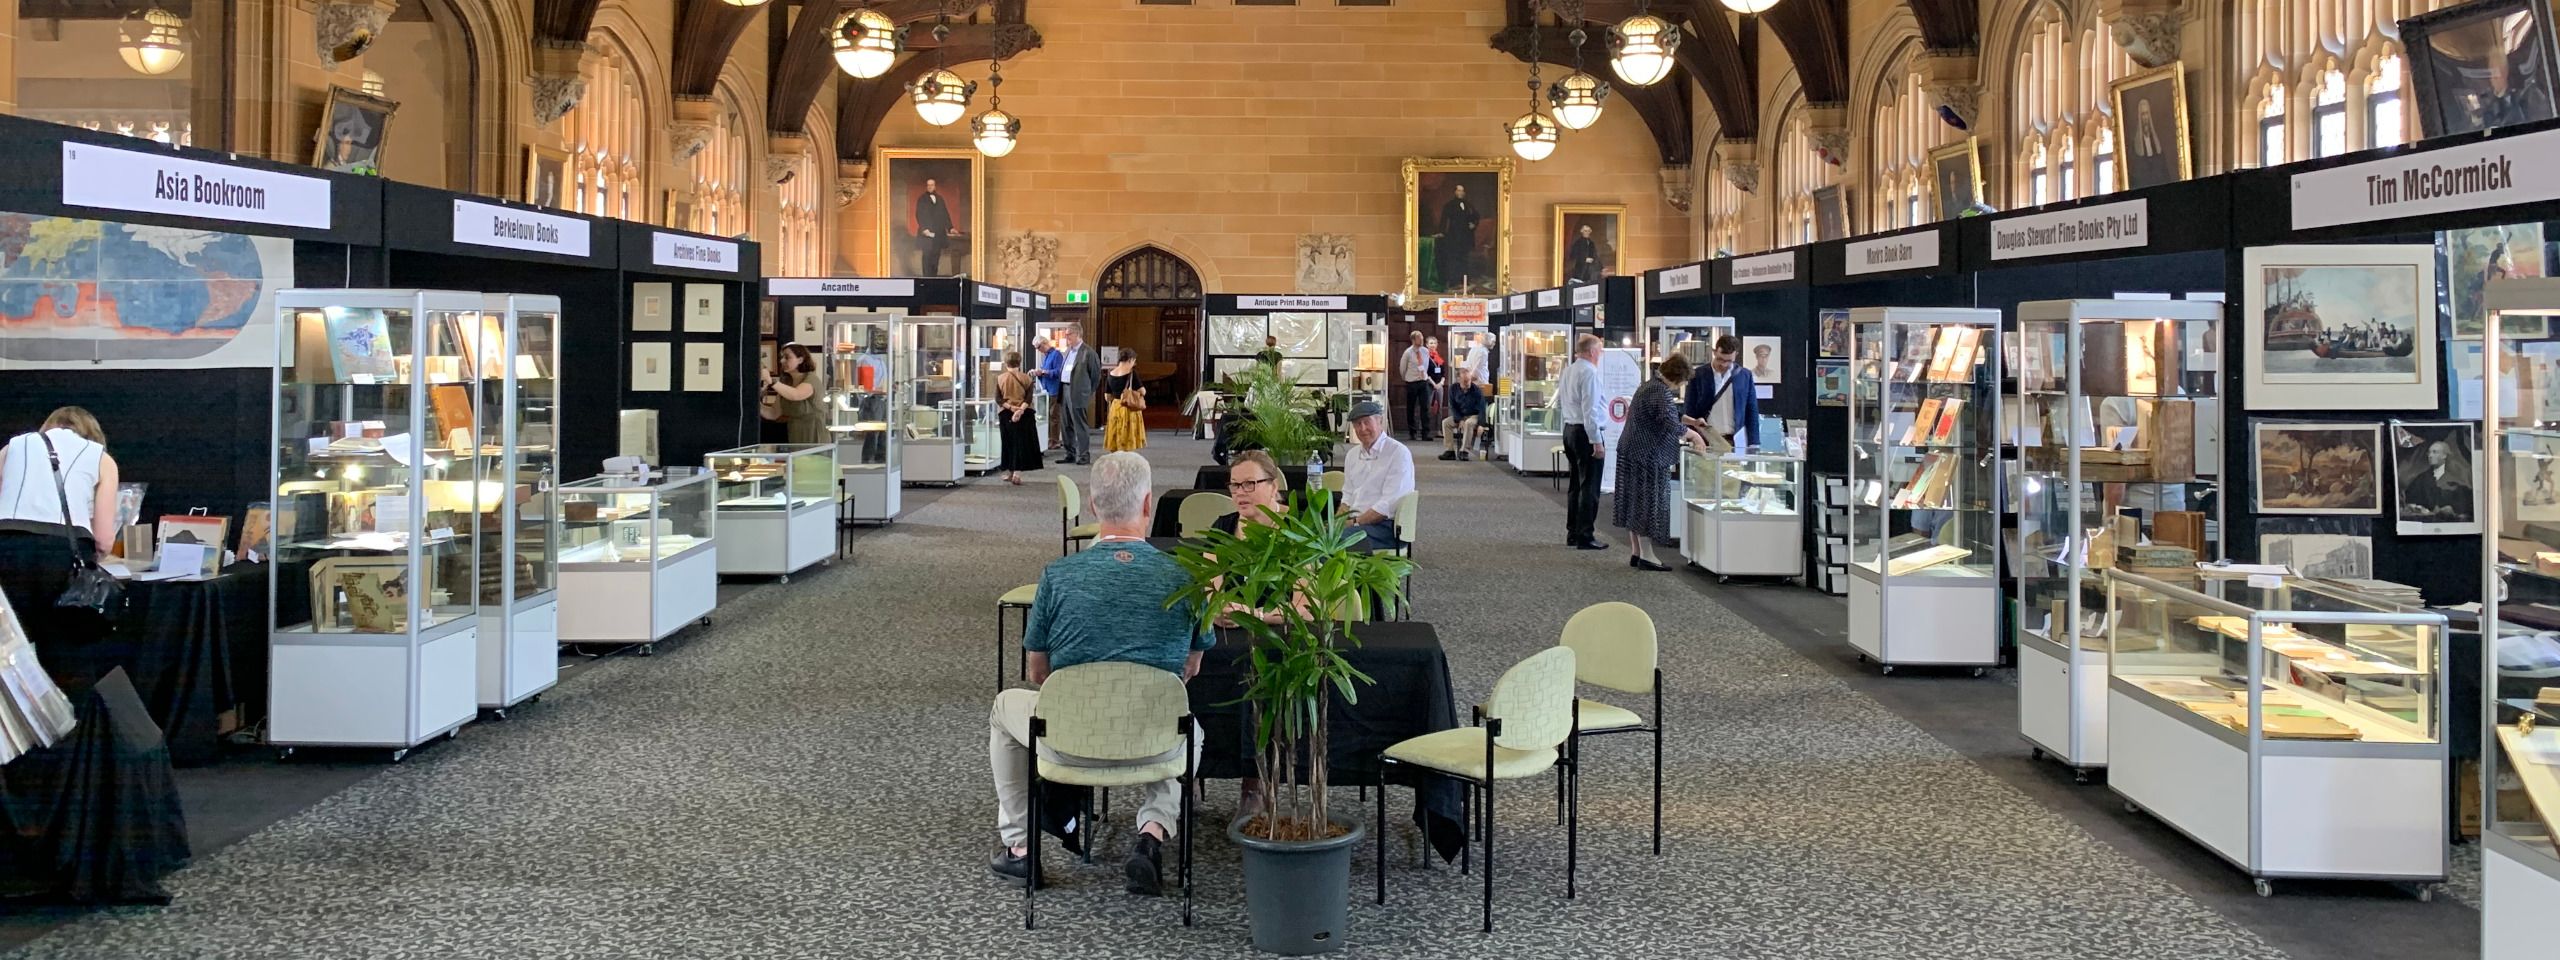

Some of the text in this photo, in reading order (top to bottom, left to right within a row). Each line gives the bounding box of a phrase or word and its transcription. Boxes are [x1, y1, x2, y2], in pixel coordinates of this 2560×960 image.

[155, 169, 265, 210] Asia Bookroom
[2366, 154, 2513, 206] Tim McCormick
[494, 215, 559, 244] Berkelouw Books
[1997, 212, 2137, 250] Douglas Stewart Fine Books Pty Ltd
[1866, 243, 1913, 265] Mark's Book Barn
[821, 282, 860, 292] Ancanthe
[1254, 298, 1278, 306] Antique
